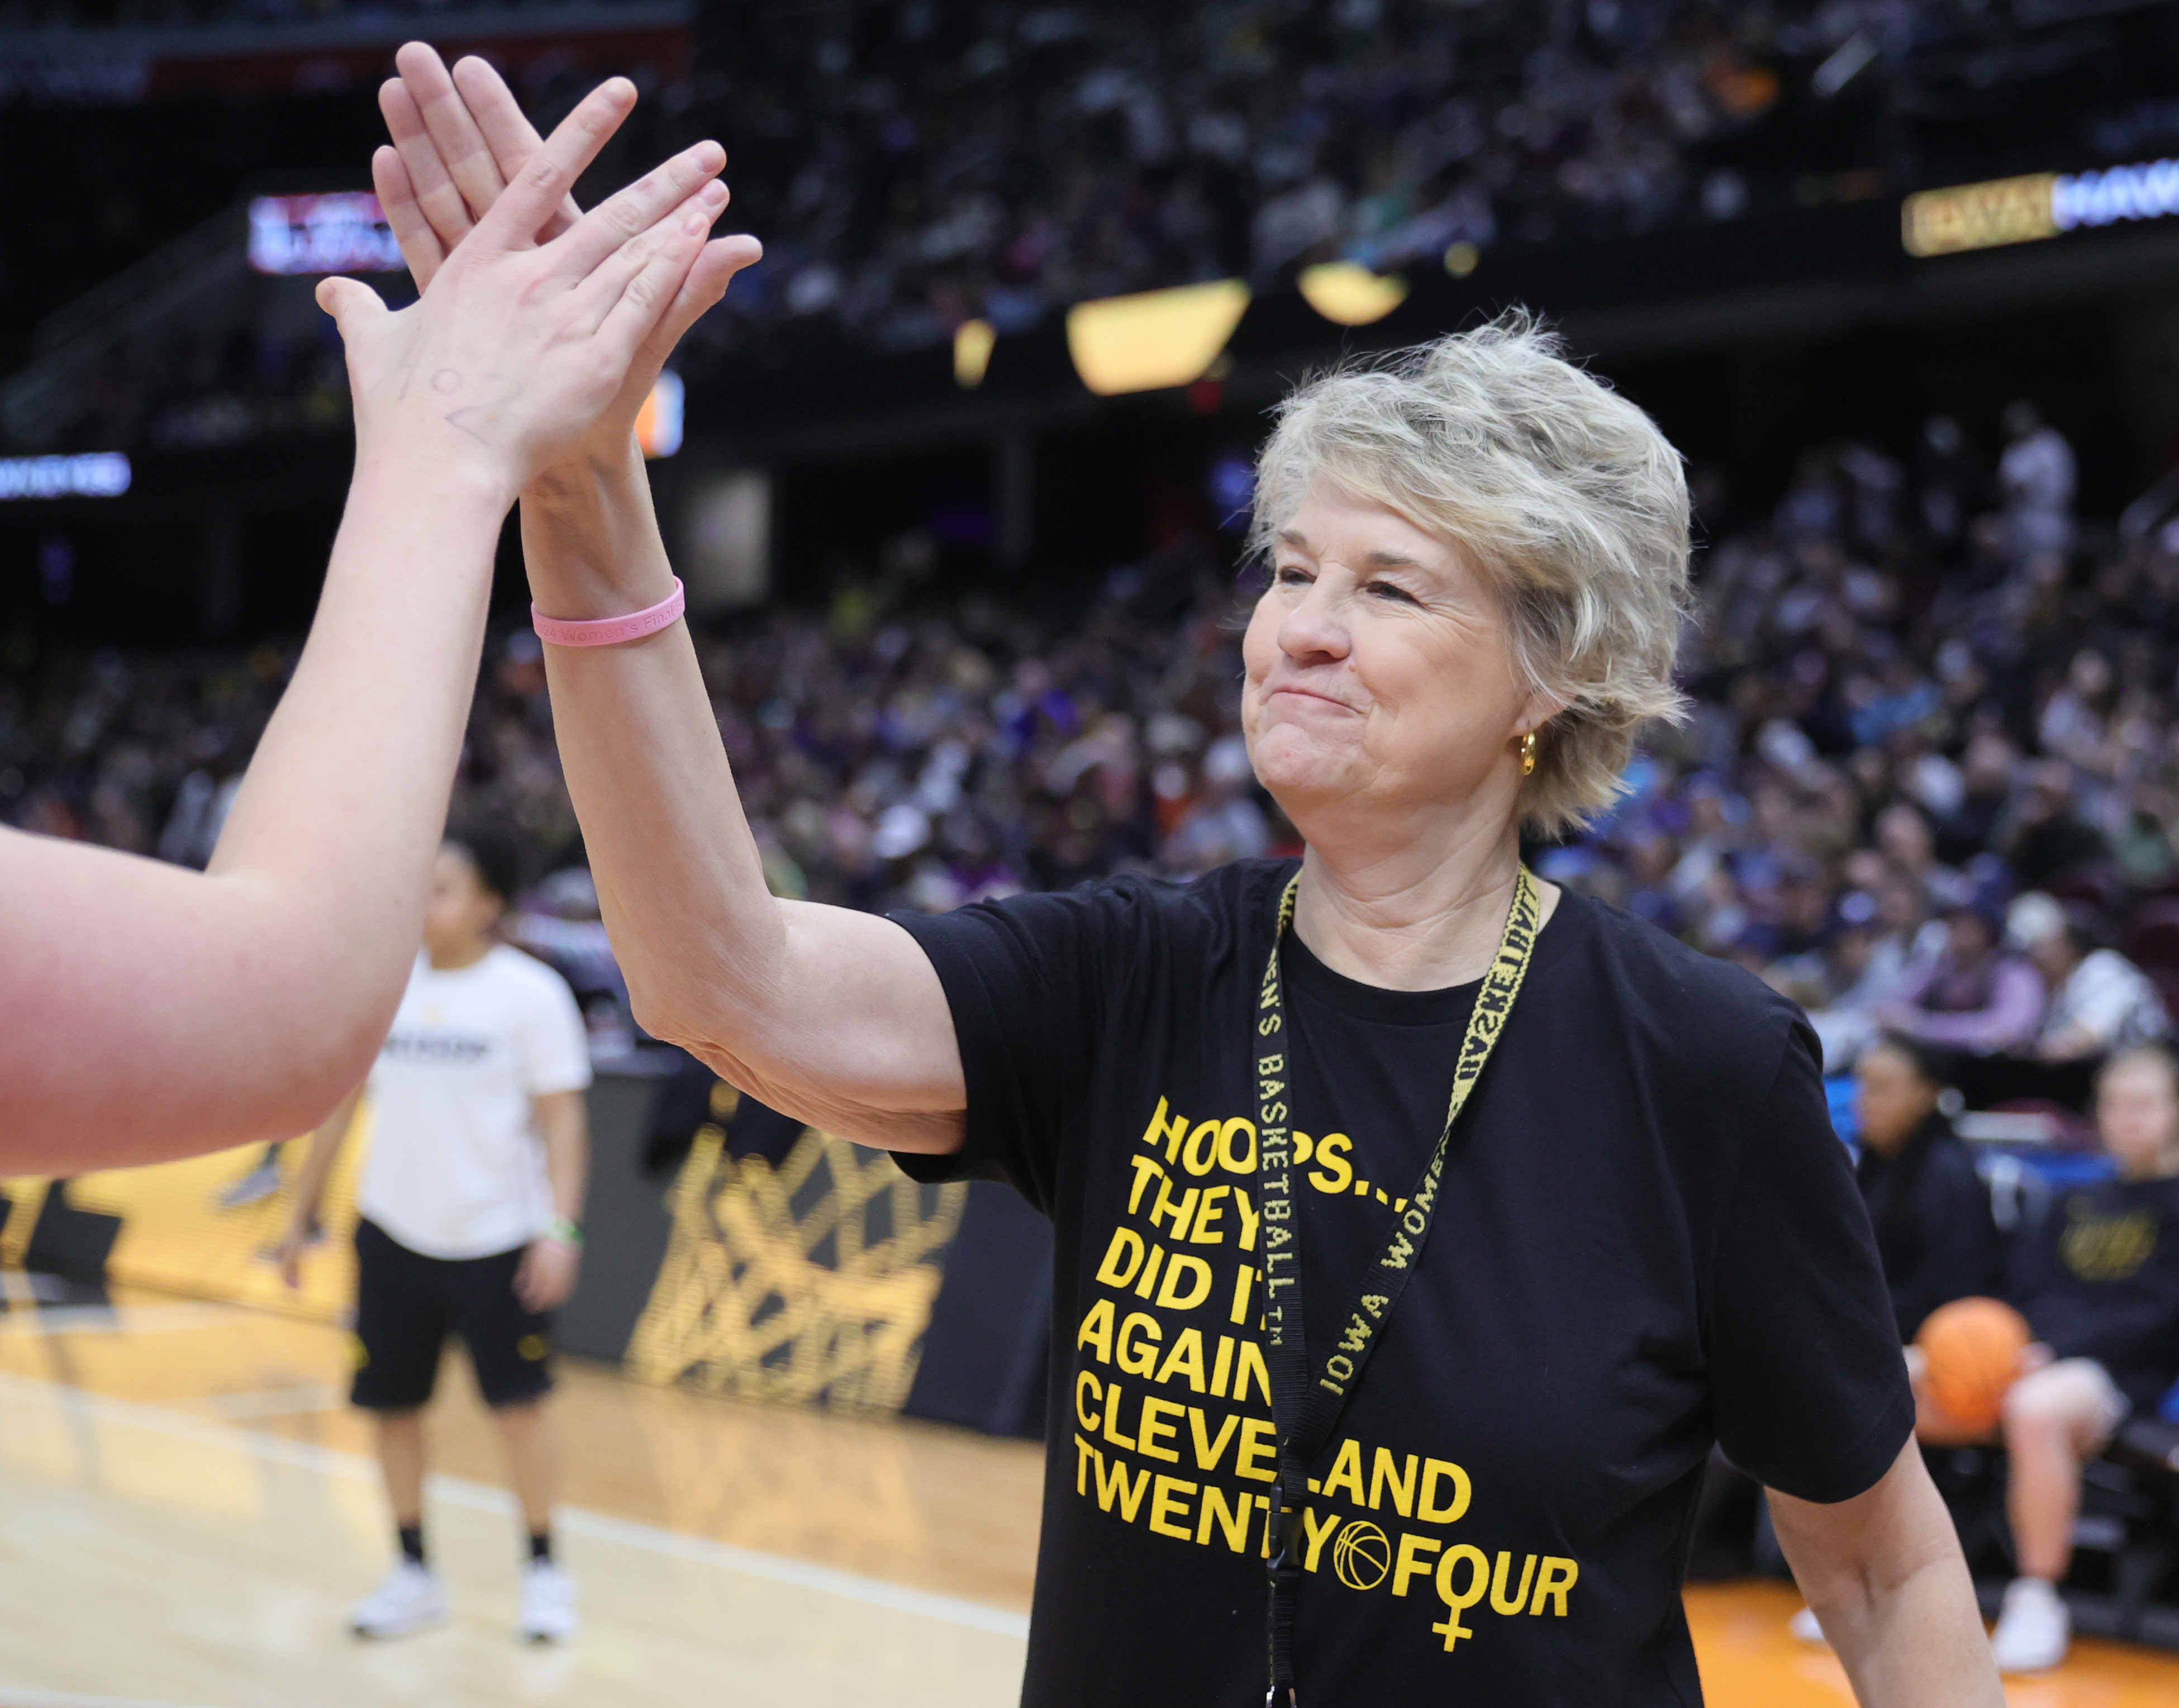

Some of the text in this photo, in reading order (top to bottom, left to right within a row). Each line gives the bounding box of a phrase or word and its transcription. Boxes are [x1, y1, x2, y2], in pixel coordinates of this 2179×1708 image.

[562, 622, 638, 643] Women's
[644, 605, 674, 631] Final
[1127, 1154, 1260, 1252] THEY
[1258, 1053, 1295, 1298] BASKETBALL
[1096, 1226, 1267, 1331] DID I
[1077, 1298, 1272, 1407] AGAIN
[1320, 1293, 1390, 1395] IOWA
